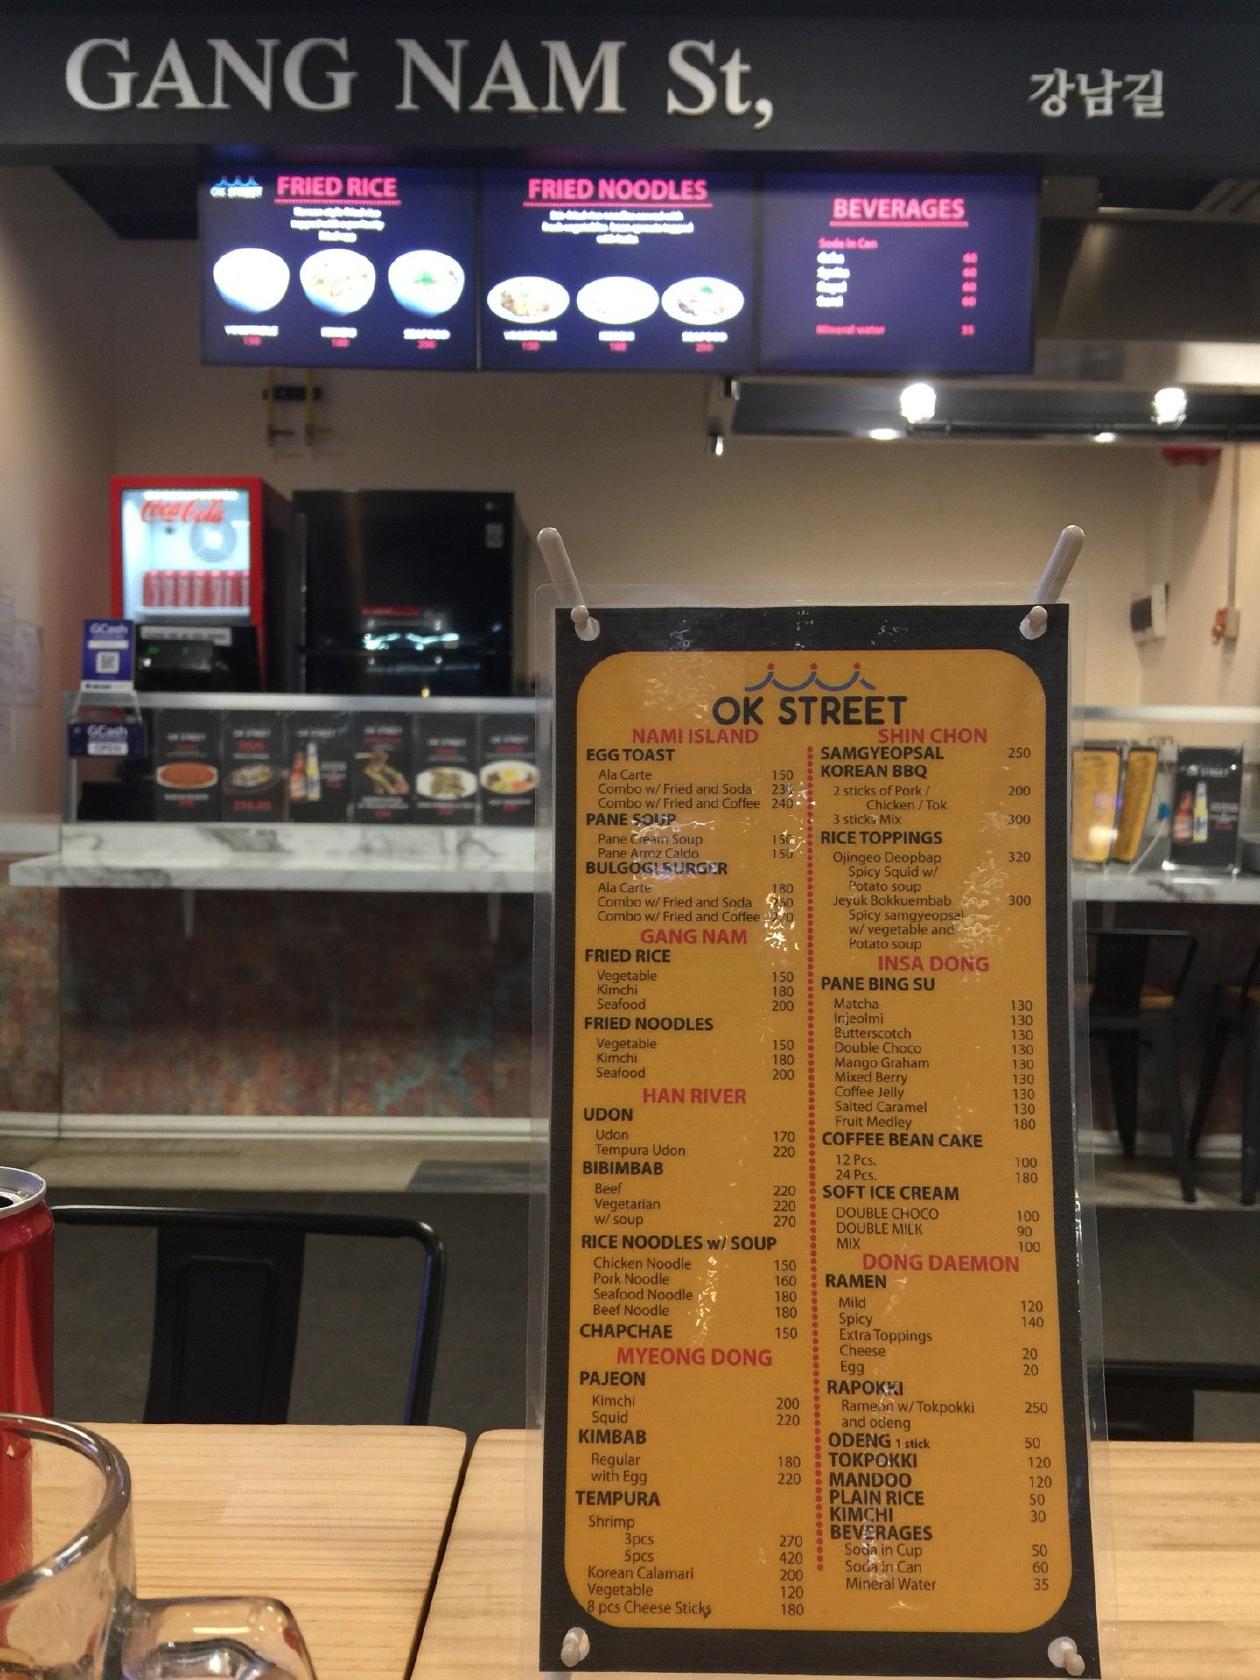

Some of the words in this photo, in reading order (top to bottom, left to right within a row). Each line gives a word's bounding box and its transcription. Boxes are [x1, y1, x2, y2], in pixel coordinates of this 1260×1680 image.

[65, 38, 359, 112] GANG
[396, 39, 626, 114] NAM
[667, 39, 774, 130] St,
[1029, 67, 1165, 118] 강남길
[277, 176, 342, 196] FRIED
[347, 177, 397, 197] RICE
[528, 179, 593, 200] FRIED
[599, 179, 708, 200] NOODLES
[833, 198, 965, 219] BEVERAGES
[712, 696, 764, 725] OK
[778, 696, 907, 725] STREET
[632, 729, 683, 744] NAMI
[689, 729, 759, 744] ISLAND
[878, 728, 924, 743] SHIN
[930, 728, 987, 743] CHON
[586, 749, 619, 761] EGG
[623, 749, 675, 761] TOAST
[821, 747, 944, 760] SAMGYEOPSAL
[620, 770, 652, 780] Carte
[772, 770, 793, 780] 150
[821, 765, 887, 777] KOREAN
[893, 765, 927, 779] BBQ
[598, 783, 641, 794] Combo
[664, 783, 692, 794] Fried
[723, 784, 752, 795] Soda
[844, 786, 876, 796] sticks
[722, 798, 760, 809] Coffee
[772, 798, 793, 809] 240
[586, 813, 627, 825] PANE
[633, 813, 676, 826] SOUP
[880, 815, 901, 824] Mix
[1008, 815, 1030, 825] 300
[598, 834, 627, 844] Pane
[631, 834, 668, 844] Cream
[672, 834, 703, 847] Soup
[821, 831, 856, 844] RICE
[860, 831, 942, 844] TOPPINGS
[631, 849, 661, 859] Arroz
[665, 848, 699, 859] Caldo
[833, 852, 881, 865] Ojingeo
[885, 852, 941, 867] Deopbap
[1009, 852, 1031, 862] 320
[849, 866, 880, 880] Spicy
[772, 884, 793, 893] 180
[849, 881, 888, 891] Potato
[833, 895, 867, 910] Jeyuk
[871, 895, 952, 906] Bokkuembab
[640, 929, 697, 944] GANG
[703, 929, 747, 944] NAM
[868, 924, 928, 938] vegetable
[585, 949, 631, 963] FRIED
[636, 949, 670, 963] RICE
[878, 956, 924, 971] INSA
[930, 956, 989, 971] DONG
[597, 970, 657, 983] Vegetable
[597, 984, 638, 995] Kimchi
[822, 977, 864, 990] PANE
[869, 977, 908, 991] BING
[913, 977, 935, 991] SU
[597, 998, 645, 1010] Seafood
[584, 1017, 631, 1030] FRIED
[635, 1017, 714, 1031] NOODLES
[834, 1013, 883, 1025] Injeolmi
[1011, 1015, 1033, 1025] 130
[835, 1027, 911, 1039] Butterscotch
[835, 1057, 878, 1070] Mango
[881, 1057, 929, 1068] Graham
[642, 1088, 684, 1104] HAN
[691, 1088, 746, 1104] RIVER
[879, 1087, 904, 1100] Jelly
[835, 1101, 872, 1112] Salted
[584, 1108, 633, 1121] UDON
[836, 1116, 863, 1127] Fruit
[867, 1117, 912, 1130] Medley
[596, 1130, 628, 1140] Udon
[822, 1132, 884, 1146] COFFEE
[889, 1133, 934, 1147] BEAN
[938, 1134, 983, 1148] CAKE
[596, 1144, 648, 1158] Tempura
[854, 1154, 876, 1166] Pcs.
[1016, 1157, 1037, 1168] 100
[583, 1161, 663, 1175] BIBIMBAB
[595, 1183, 622, 1194] Beef
[773, 1186, 795, 1196] 220
[823, 1185, 865, 1199] SOFT
[871, 1186, 895, 1199] ICE
[900, 1186, 959, 1200] CREAM
[594, 1199, 660, 1212] Vegetarian
[837, 1207, 888, 1219] DOUBLE
[892, 1208, 939, 1220] CHOCO
[613, 1216, 644, 1227] soup
[773, 1215, 795, 1227] 270
[837, 1222, 888, 1234] DOUBLE
[893, 1223, 922, 1235] MILK
[1017, 1226, 1032, 1237] 90
[582, 1235, 617, 1249] RICE
[622, 1235, 703, 1250] NOODLES
[731, 1236, 777, 1250] SOUP
[837, 1238, 860, 1249] MIX
[594, 1257, 642, 1269] Chicken
[647, 1258, 691, 1270] Noodle
[863, 1254, 923, 1270] DONG
[929, 1255, 1019, 1272] DAEMON
[594, 1273, 621, 1284] Pork
[774, 1276, 796, 1286] 160
[826, 1274, 886, 1288] RAMEN
[839, 1297, 866, 1308] Mild
[1021, 1301, 1043, 1312] 120
[1022, 1317, 1044, 1327] 140
[580, 1323, 672, 1339] CHAPCHAE
[617, 1348, 705, 1365] MYEONG
[711, 1349, 772, 1366] DONG
[1023, 1348, 1038, 1360] 20
[580, 1371, 645, 1386] PAJEON
[828, 1380, 903, 1396] RAPOKKI
[776, 1398, 799, 1409] 200
[917, 1401, 974, 1416] Tokpokki
[1025, 1402, 1047, 1413] 250
[592, 1411, 628, 1424] Squid
[579, 1429, 647, 1444] KIMBAB
[829, 1432, 891, 1448] ODENG
[905, 1439, 930, 1449] stick
[1025, 1438, 1040, 1449] 50
[592, 1453, 640, 1468] Regular
[829, 1452, 917, 1468] TOKPOKKI
[591, 1470, 619, 1482] with
[624, 1470, 647, 1486] Egg
[830, 1472, 911, 1488] MANDOO
[576, 1491, 661, 1506] TEMPURA
[830, 1490, 881, 1505] PLAIN
[886, 1491, 924, 1506] RICE
[830, 1507, 893, 1522] KIMCHI
[1031, 1510, 1046, 1522] 30
[588, 1515, 635, 1530] Shrimp
[625, 1533, 654, 1546] 3pcs
[830, 1525, 933, 1541] BEVERAGES
[625, 1550, 654, 1563] 5pcs
[897, 1544, 922, 1558] Cup
[779, 1552, 803, 1564] 420
[588, 1566, 633, 1579] Korean
[637, 1567, 693, 1579] Calamari
[1033, 1562, 1048, 1573] 60
[846, 1577, 895, 1590] Mineral
[898, 1578, 936, 1591] Water
[1034, 1578, 1049, 1591] 35
[624, 1601, 671, 1614] Cheese
[675, 1601, 711, 1616] Sticks
